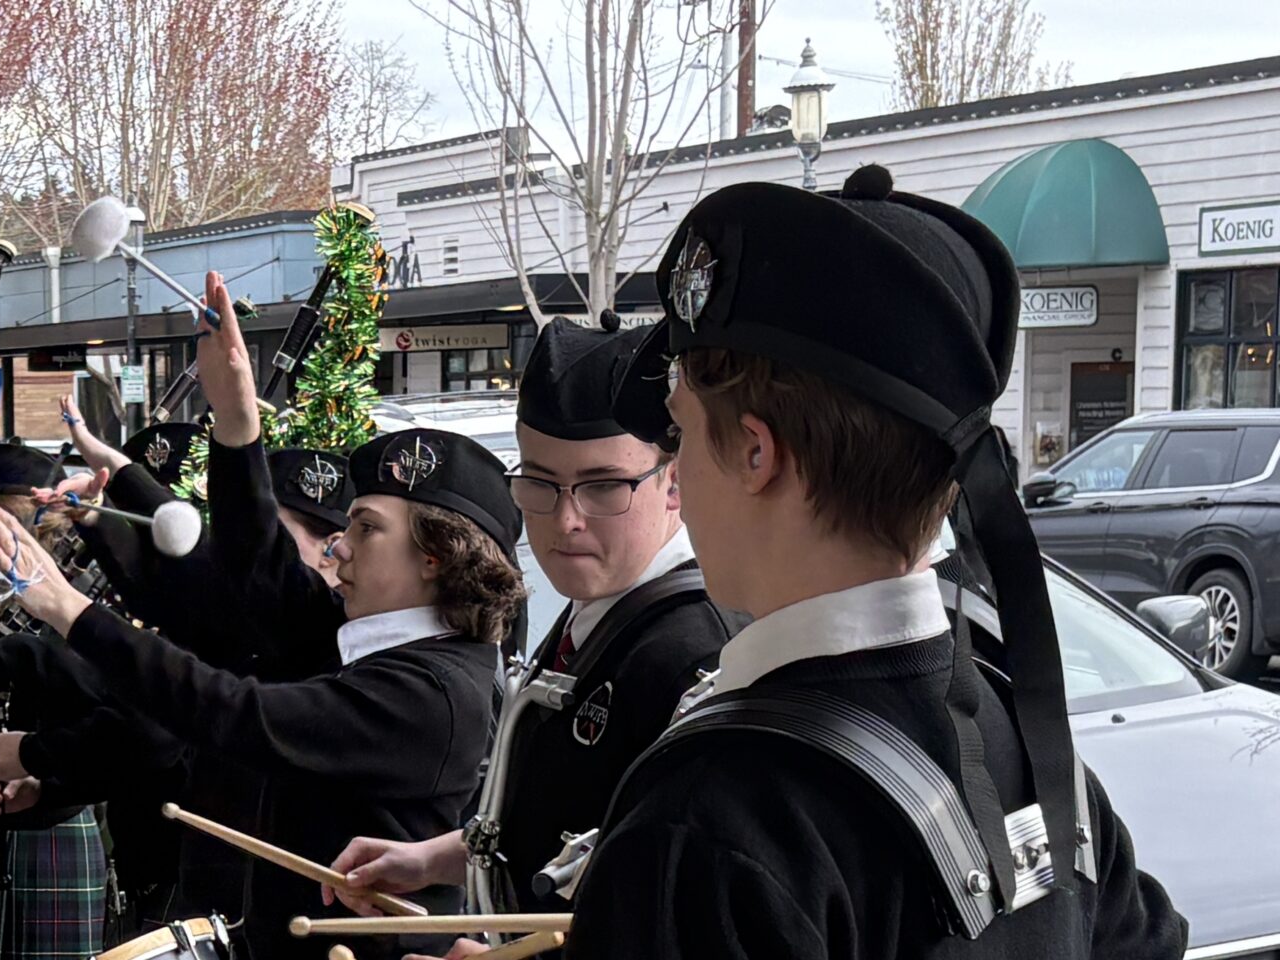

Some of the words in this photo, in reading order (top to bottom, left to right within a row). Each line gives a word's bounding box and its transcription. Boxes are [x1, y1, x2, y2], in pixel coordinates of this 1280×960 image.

[1211, 217, 1274, 243] KOENIG
[415, 334, 450, 348] twist
[454, 336, 488, 346] YOGA
